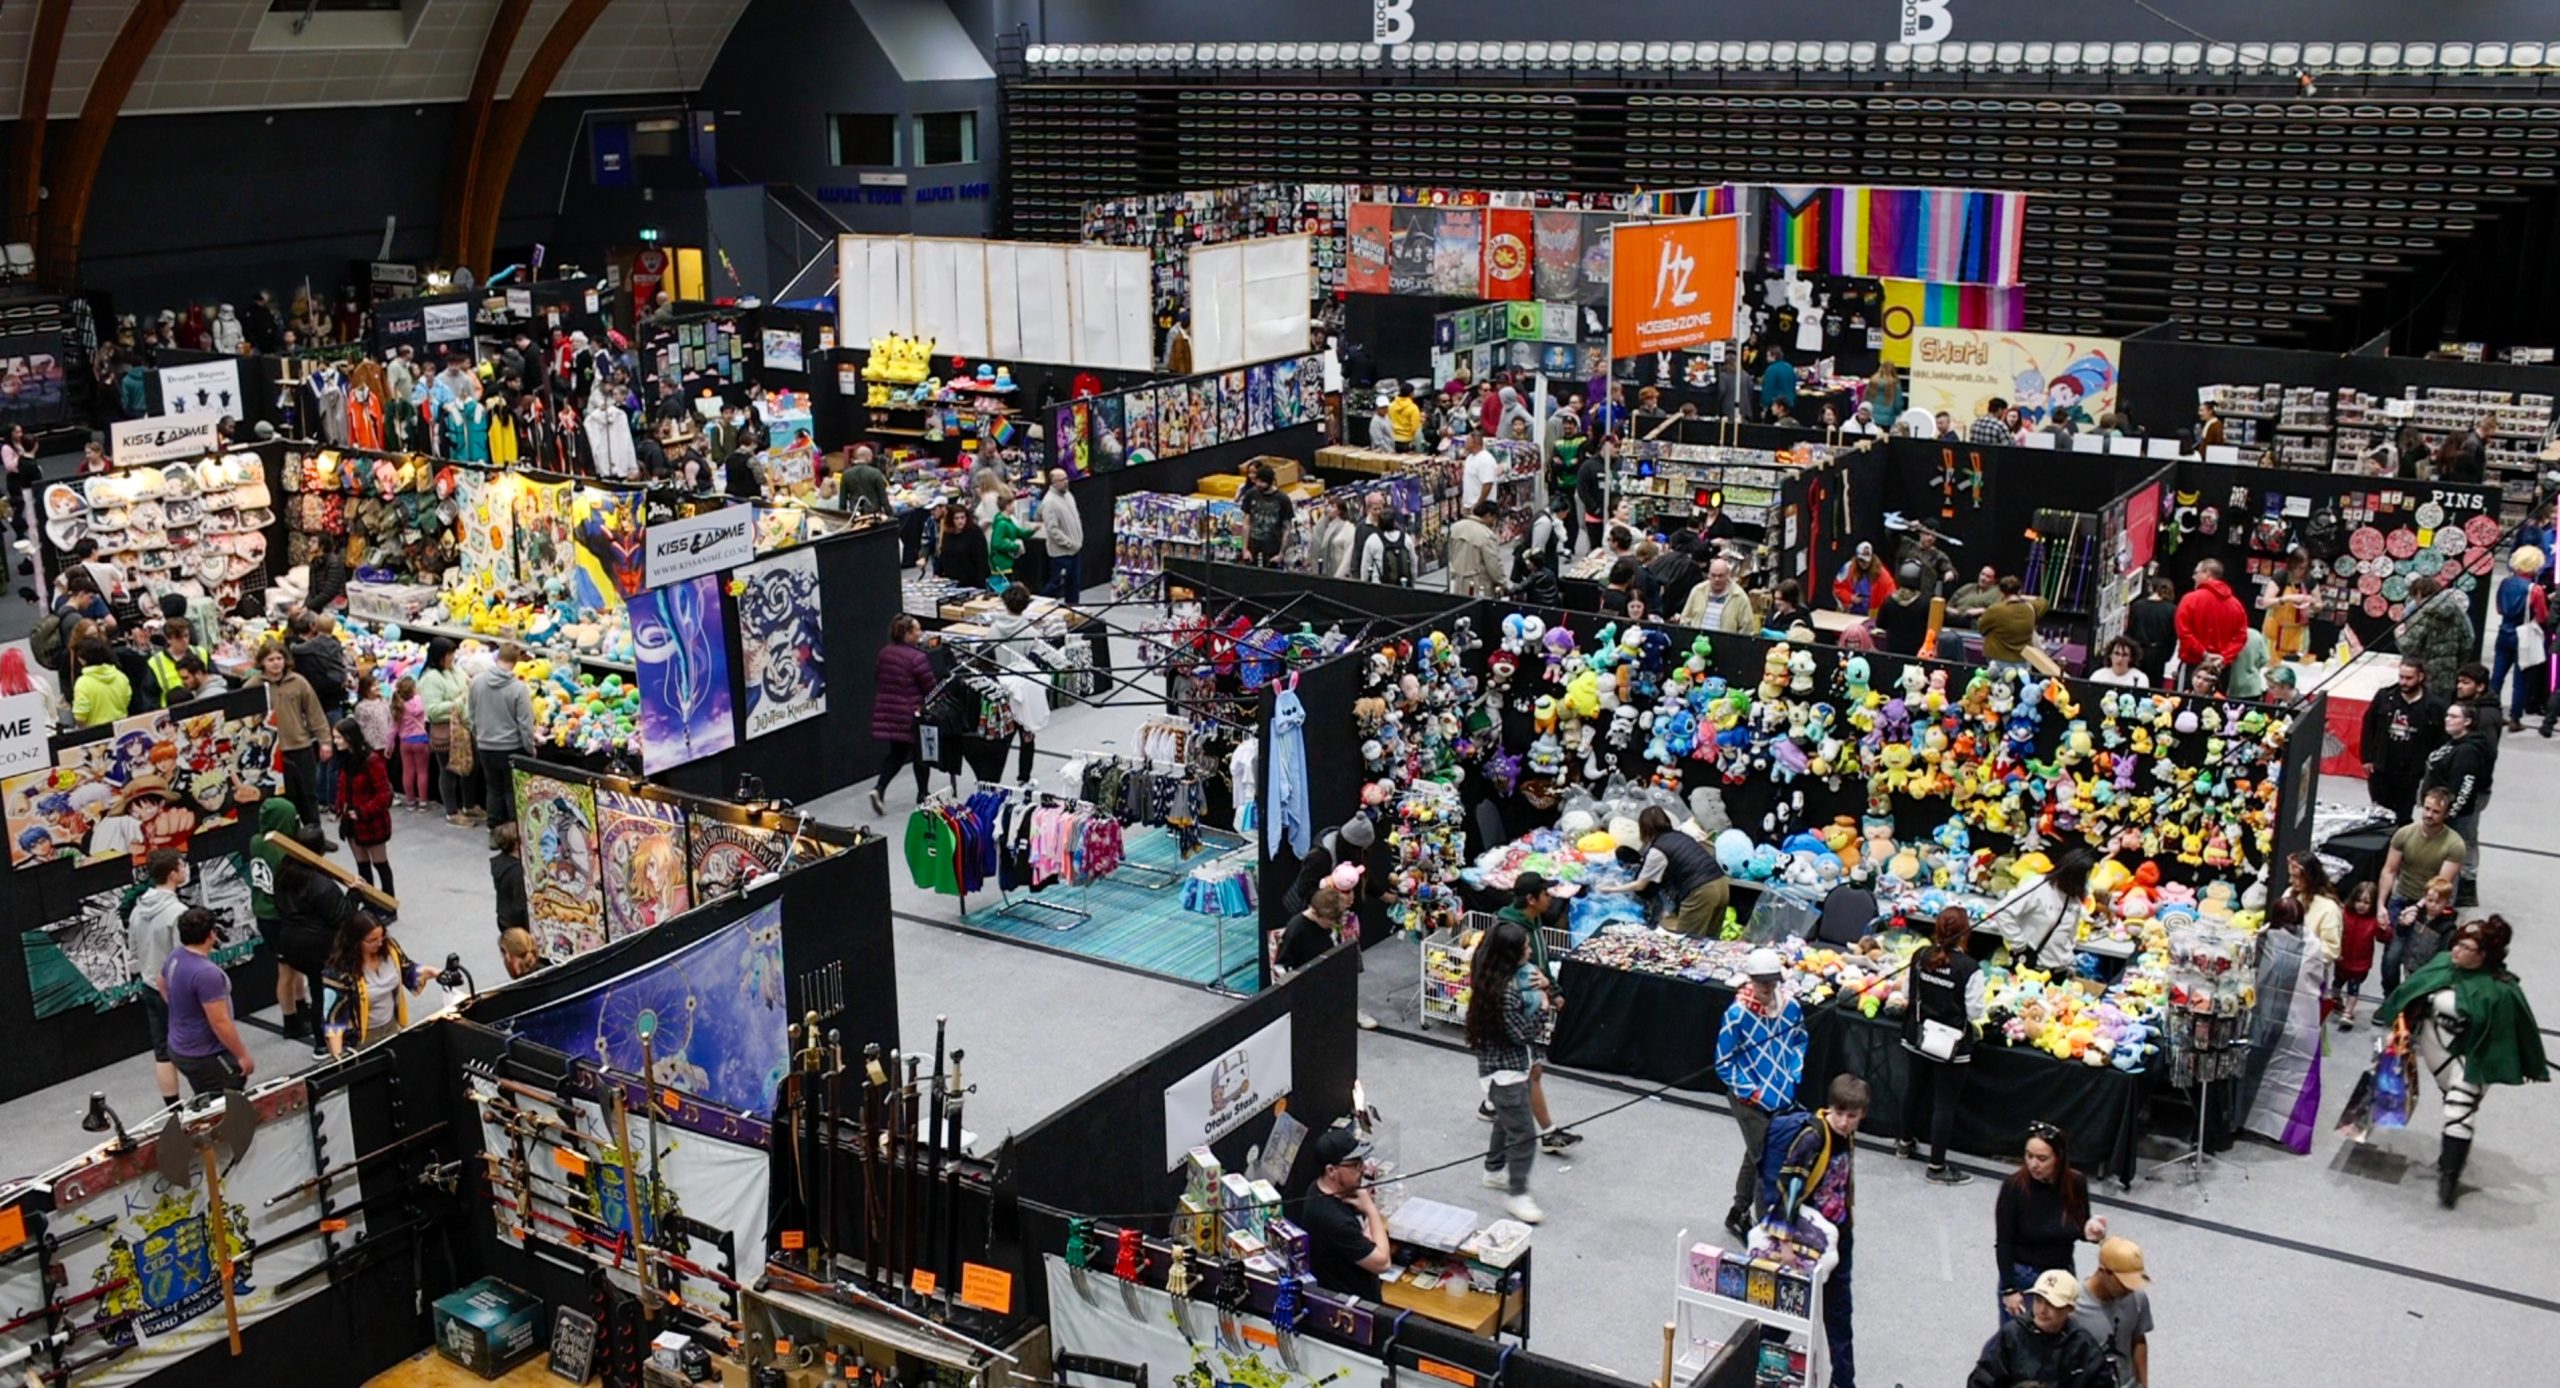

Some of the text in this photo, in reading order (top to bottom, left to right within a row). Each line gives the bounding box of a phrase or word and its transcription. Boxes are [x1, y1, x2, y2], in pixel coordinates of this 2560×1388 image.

[1636, 311, 1712, 335] HOBBYZONE
[1918, 337, 1988, 366] Sword
[122, 433, 153, 448] KISS
[2431, 489, 2485, 510] PINS
[656, 537, 689, 558] KISS
[1203, 1092, 1259, 1134] Otaku Stash
